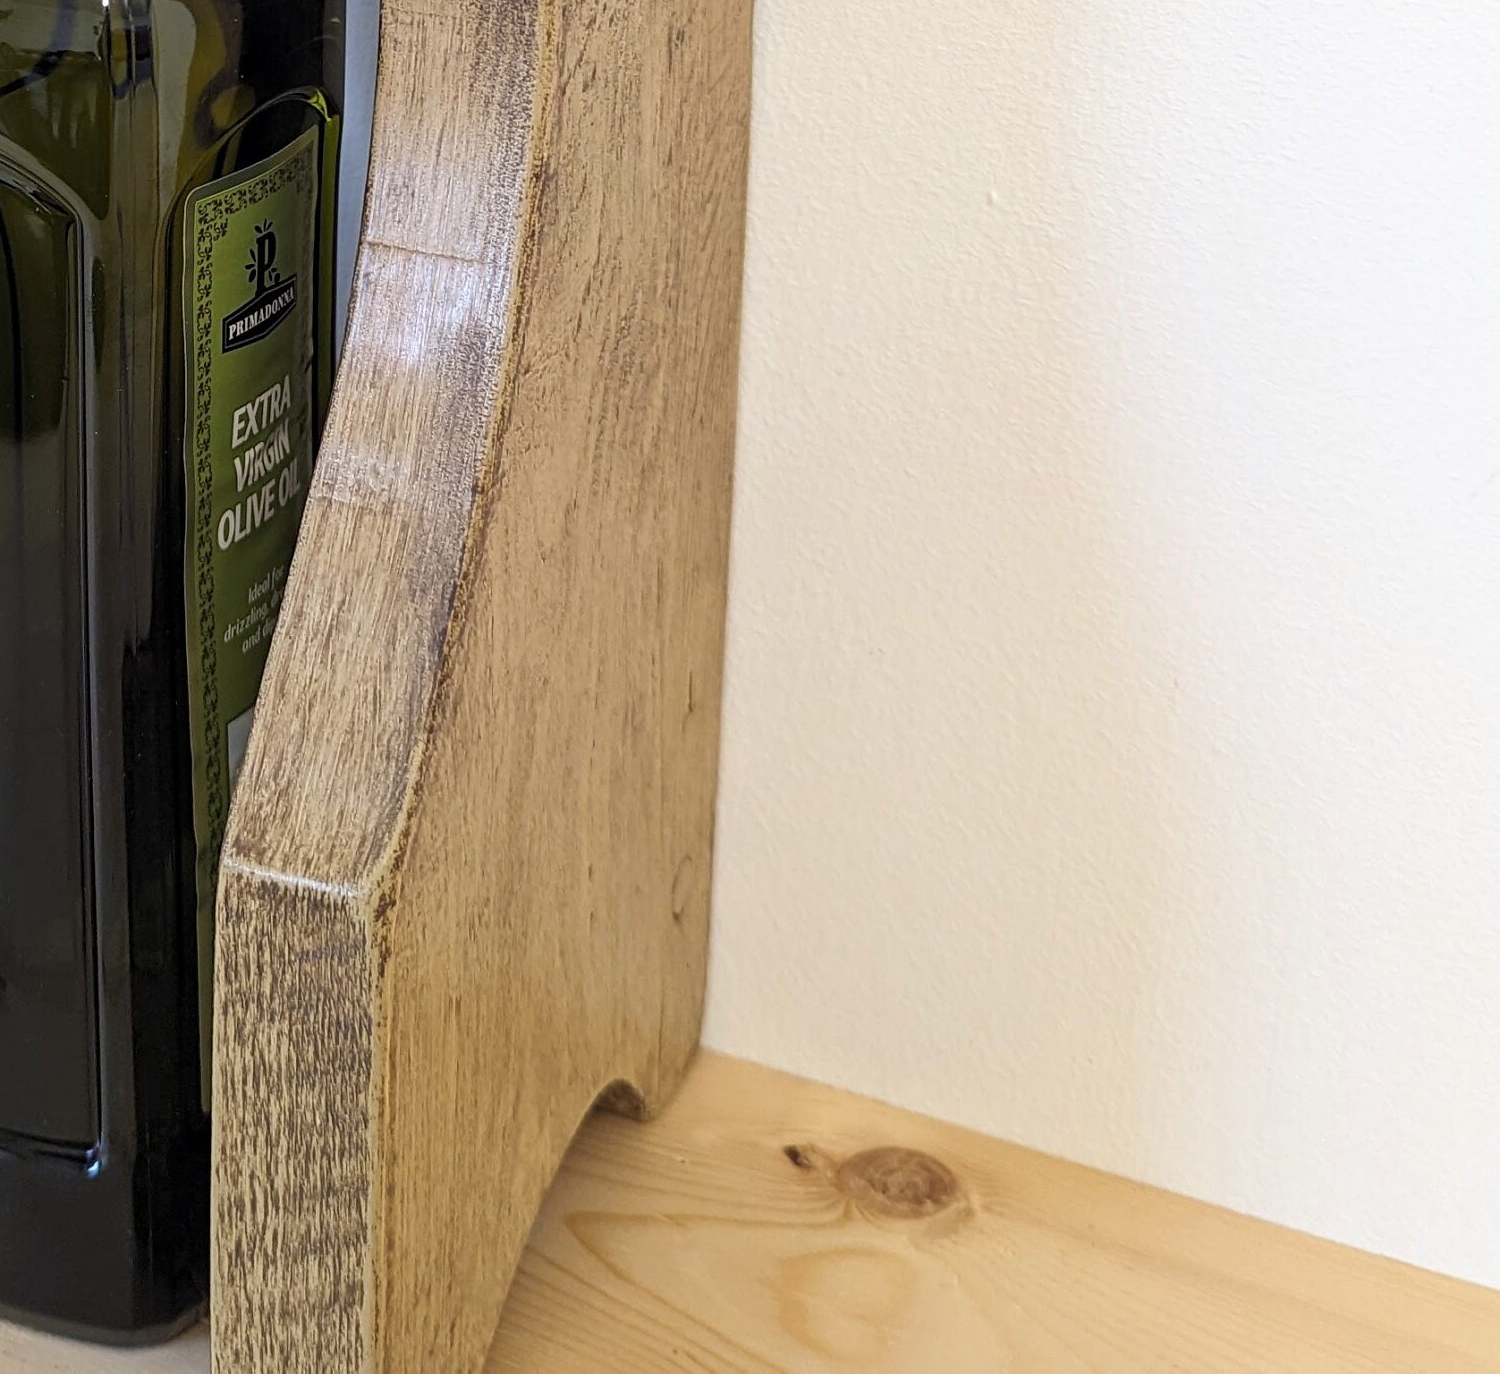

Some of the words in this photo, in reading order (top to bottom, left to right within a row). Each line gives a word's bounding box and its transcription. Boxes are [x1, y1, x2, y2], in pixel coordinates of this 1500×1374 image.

[228, 286, 295, 341] PRIMADONNA
[231, 374, 292, 450] EXTRA
[234, 417, 291, 493] VIRGIN
[217, 477, 276, 550] OLIVE
[278, 457, 301, 508] OIL
[248, 571, 271, 604] Ideal
[242, 625, 261, 654] and
